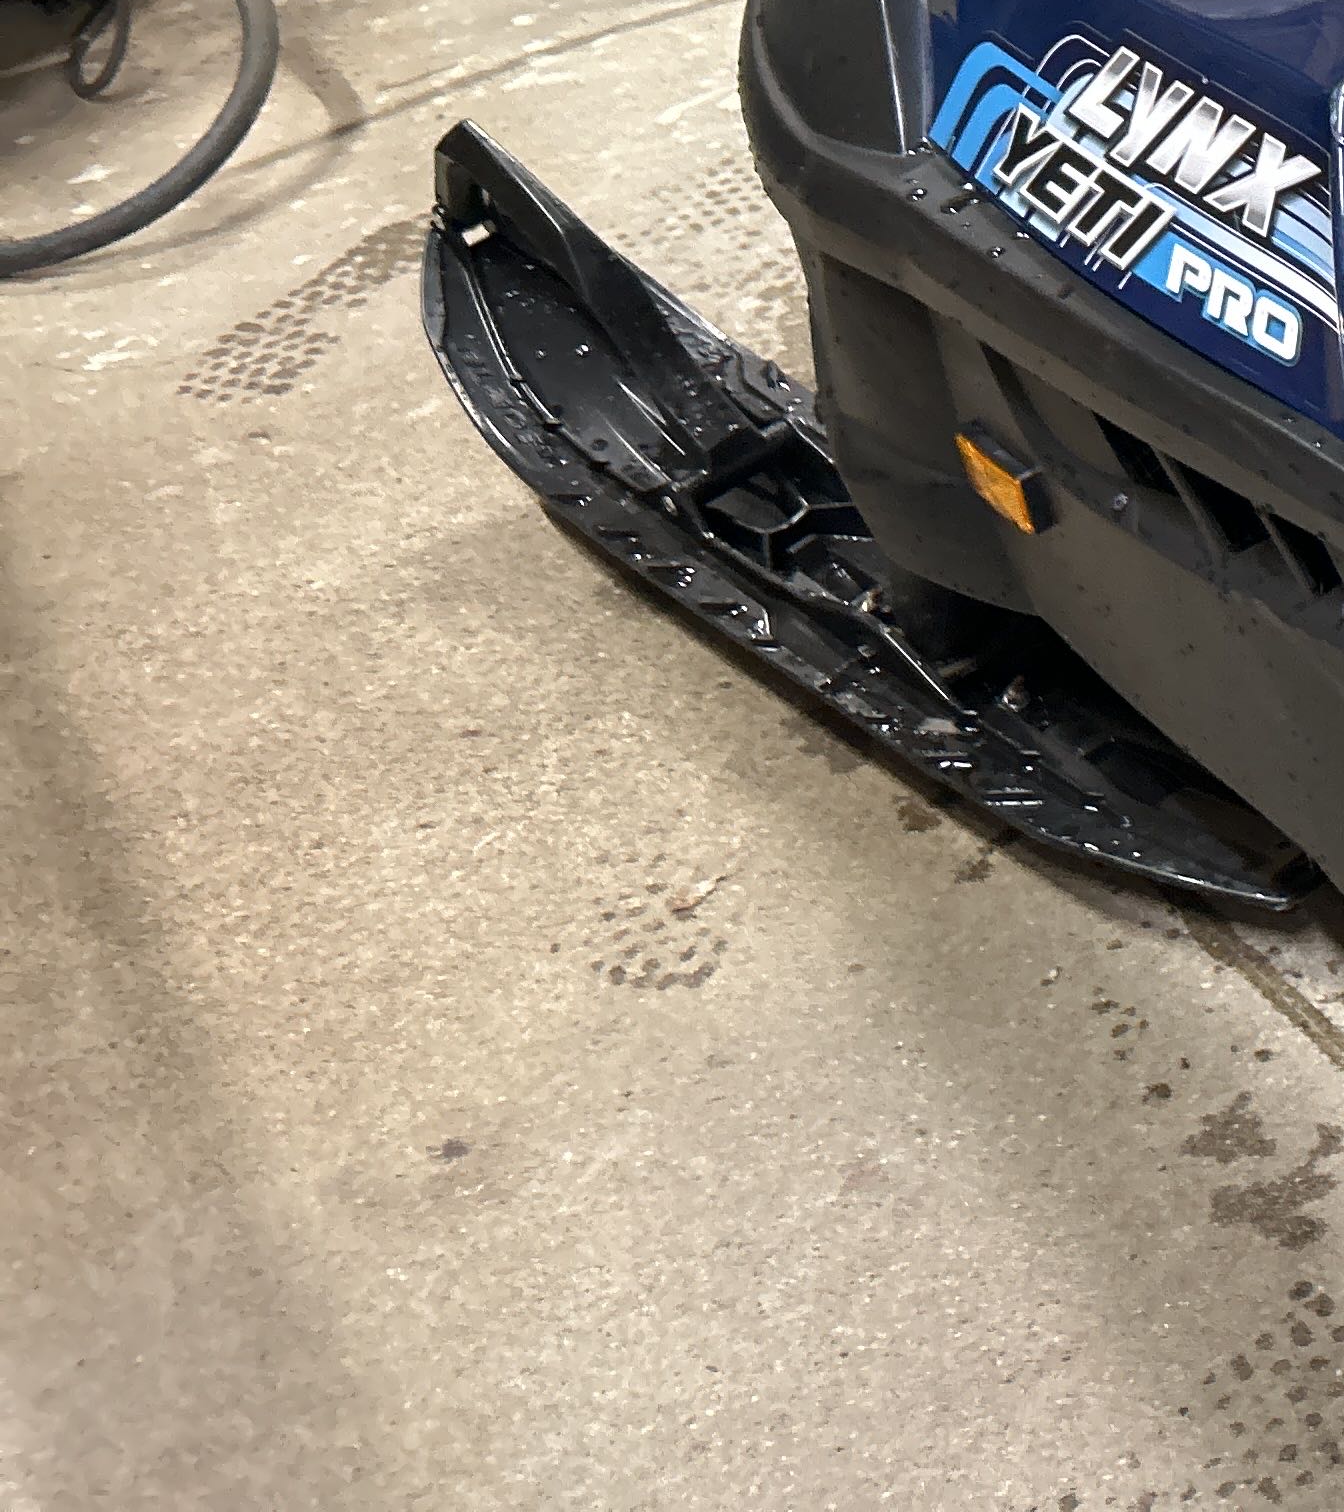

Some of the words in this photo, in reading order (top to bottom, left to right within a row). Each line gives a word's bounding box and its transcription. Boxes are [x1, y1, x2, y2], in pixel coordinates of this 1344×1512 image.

[993, 102, 1177, 271] YETI
[1166, 242, 1303, 363] PRO
[1069, 45, 1322, 238] LYNX
